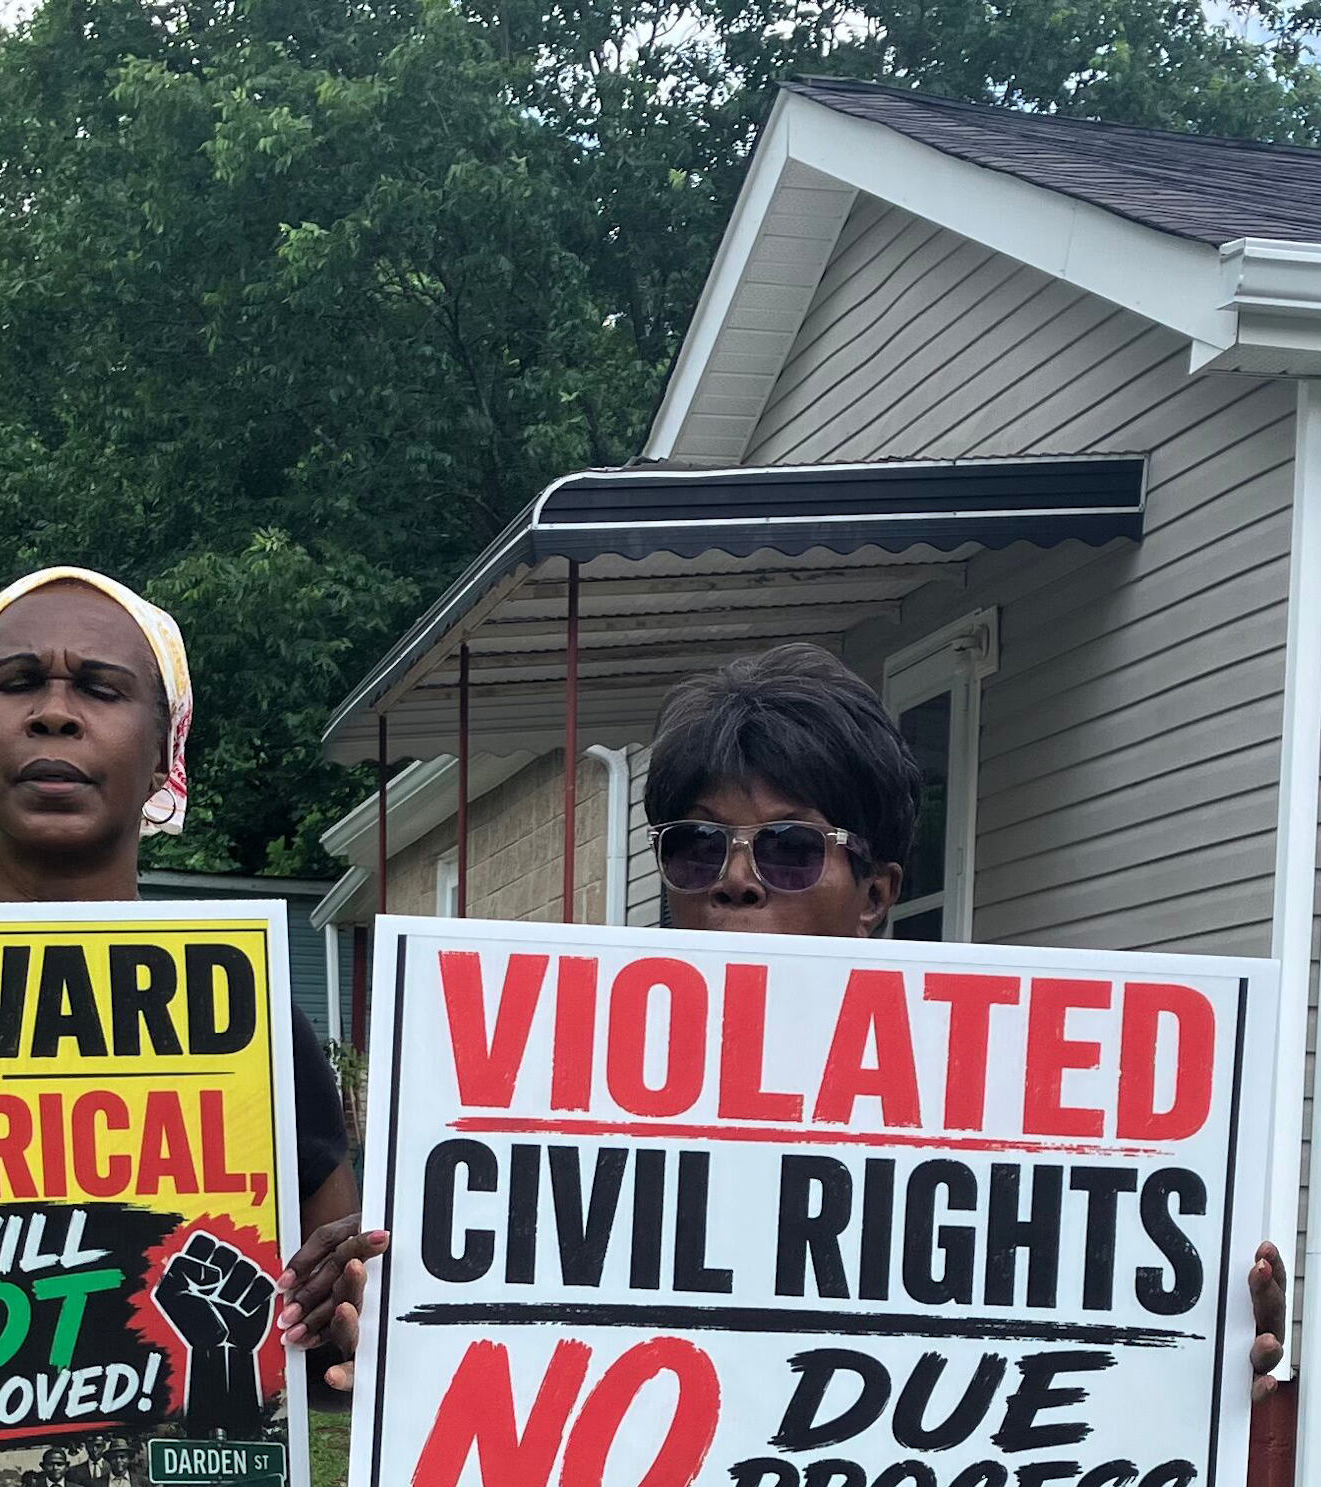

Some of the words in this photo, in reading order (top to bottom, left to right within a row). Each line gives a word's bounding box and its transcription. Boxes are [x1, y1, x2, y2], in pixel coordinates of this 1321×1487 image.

[437, 950, 1215, 1142] VIOLATED
[421, 1137, 733, 1295] CIVIL
[776, 1153, 1208, 1316] RIGHTS
[164, 1448, 247, 1475] DARDEN
[254, 1455, 269, 1470] ST
[769, 1348, 1120, 1454] DUE
